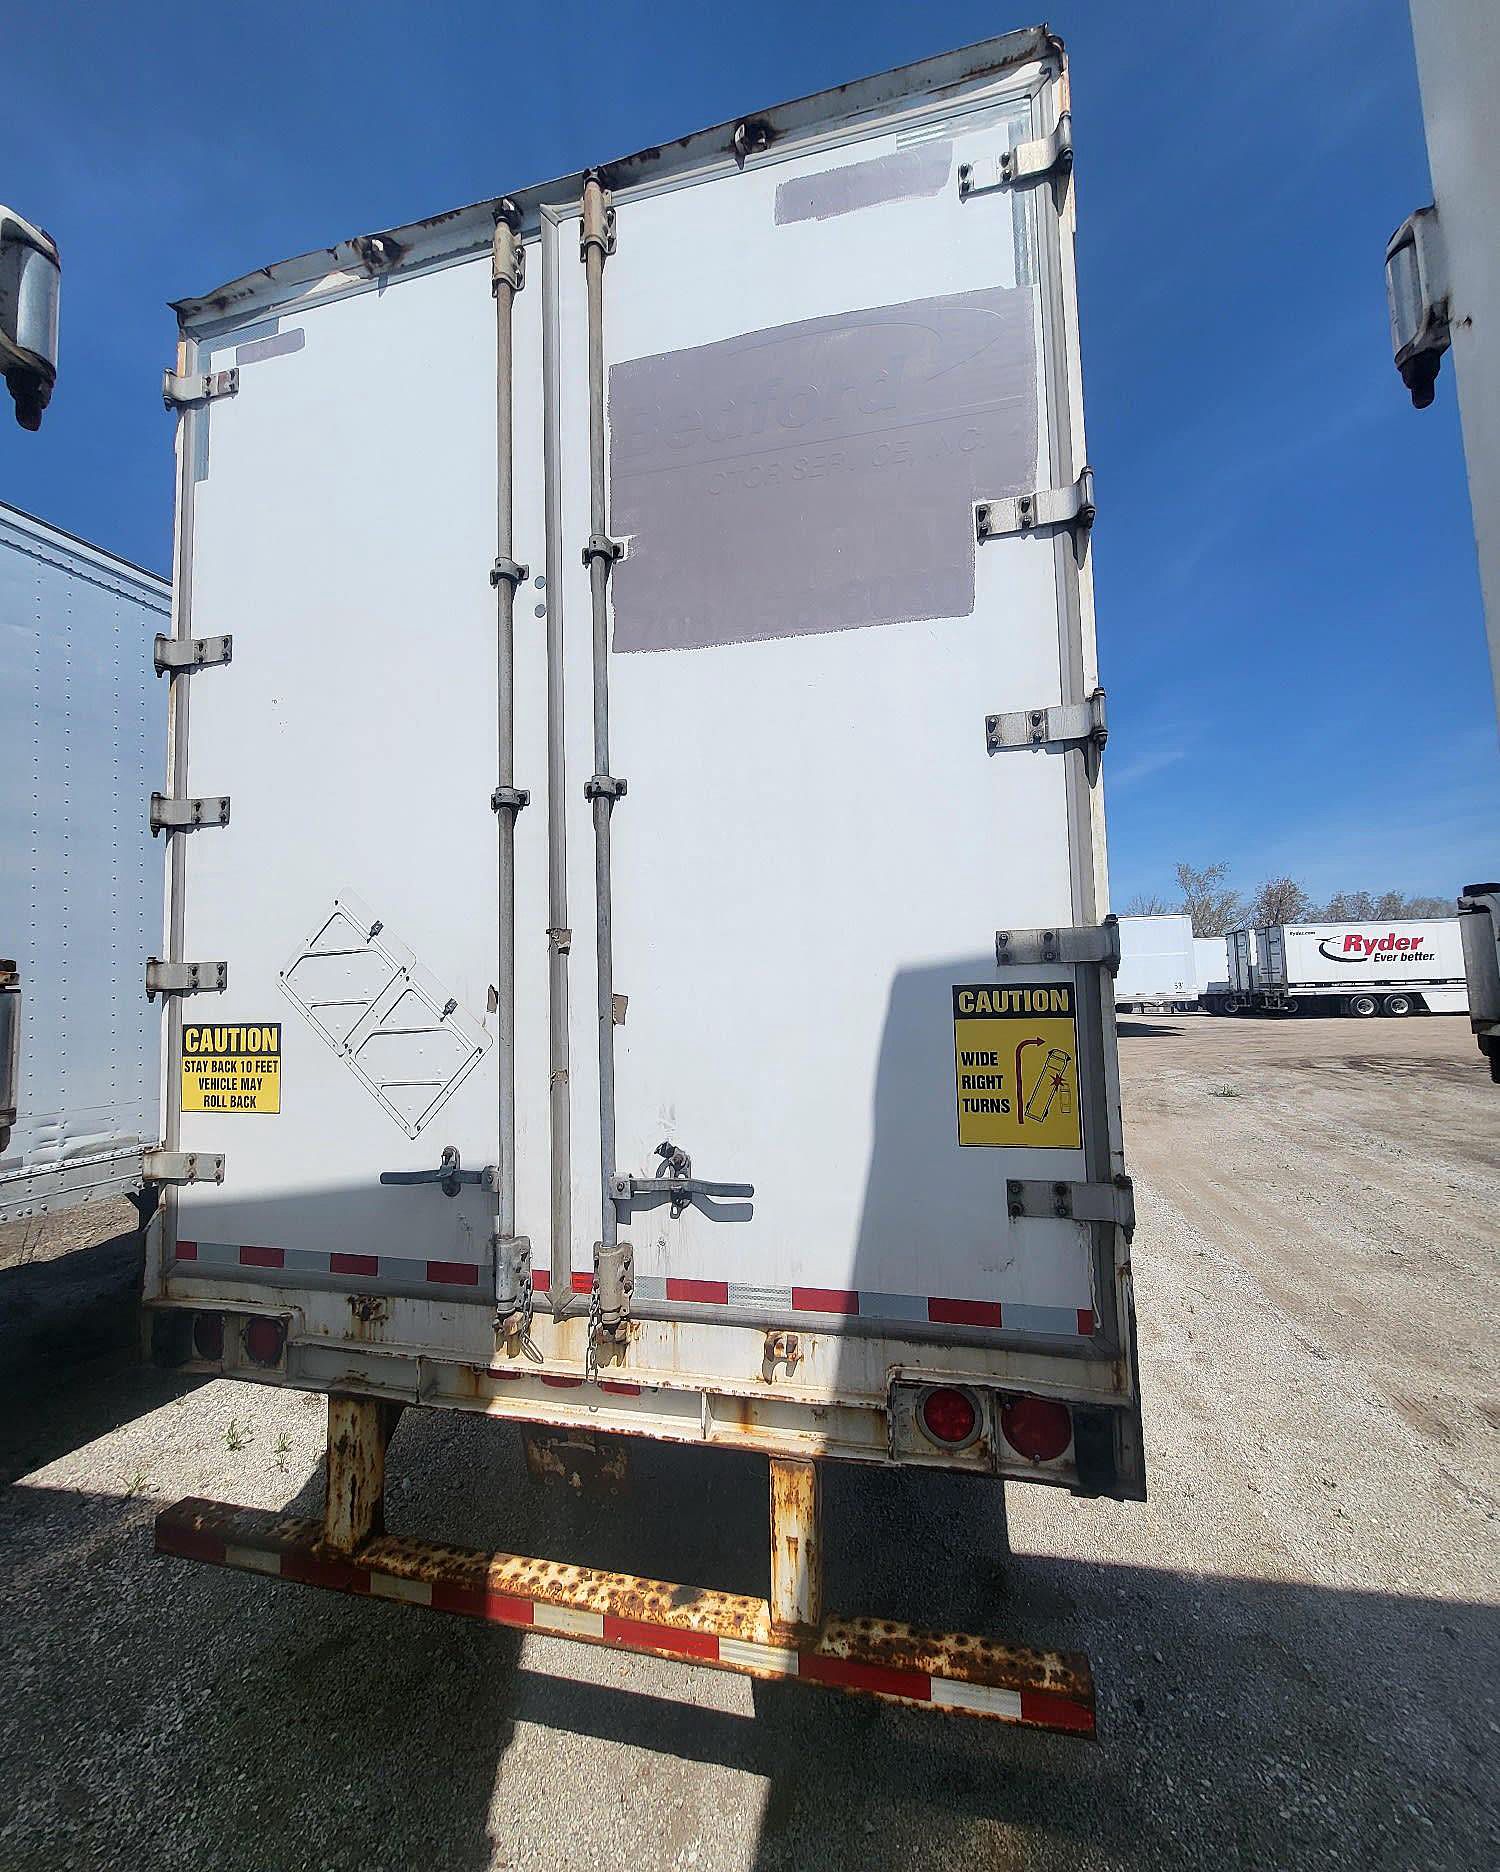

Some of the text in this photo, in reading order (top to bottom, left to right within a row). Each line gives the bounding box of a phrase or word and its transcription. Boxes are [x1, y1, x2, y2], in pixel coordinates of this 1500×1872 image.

[1343, 933, 1424, 955] Ryder
[1373, 952, 1435, 962] Ever better.
[958, 989, 1069, 1013] CAUTION
[185, 1027, 278, 1053] CAUTION
[961, 1051, 998, 1066] WIDE
[184, 1060, 278, 1073] STAY BACK 10 FEET
[199, 1077, 263, 1091] VEHICLE MAY
[961, 1075, 1004, 1090] RIGHT
[203, 1095, 257, 1109] ROLL BACK
[962, 1098, 1011, 1114] TURNS
